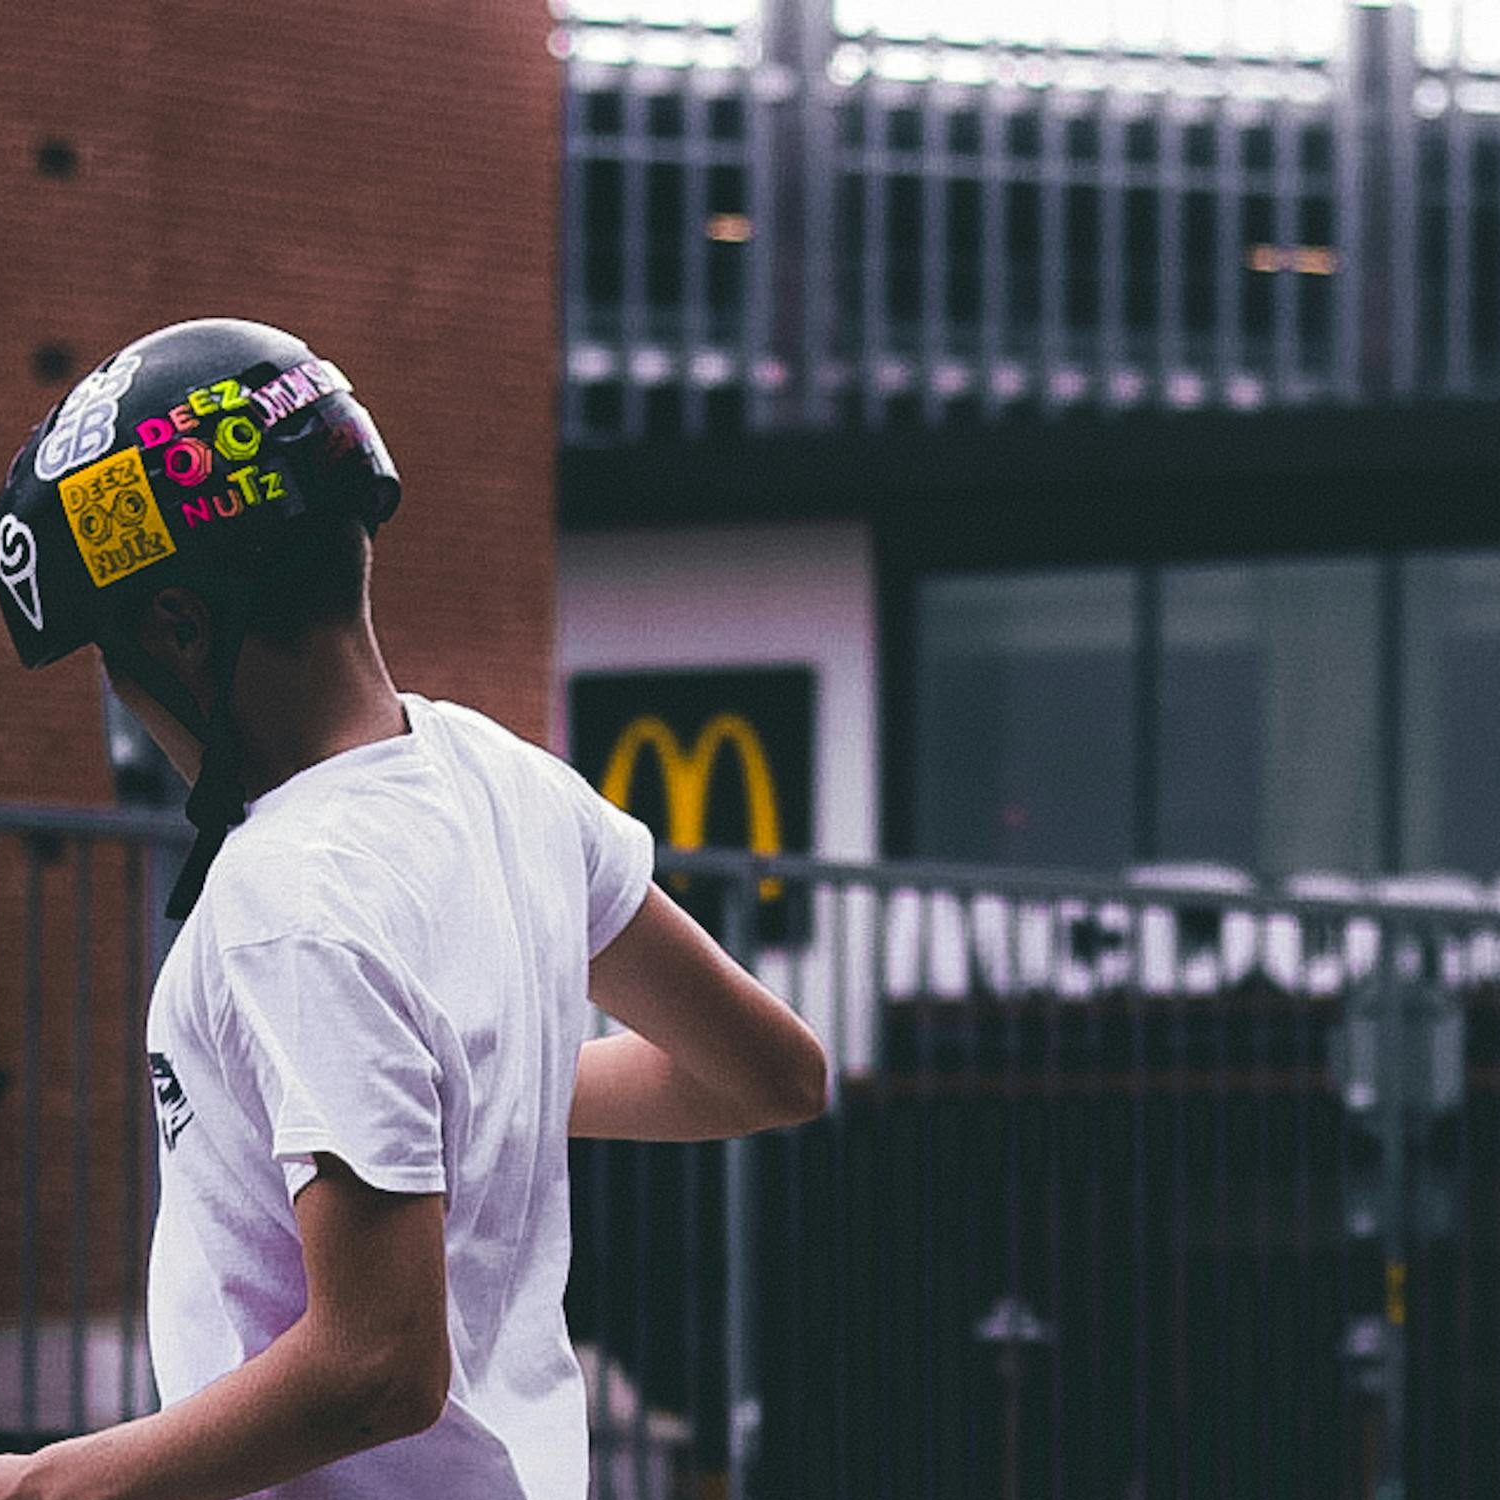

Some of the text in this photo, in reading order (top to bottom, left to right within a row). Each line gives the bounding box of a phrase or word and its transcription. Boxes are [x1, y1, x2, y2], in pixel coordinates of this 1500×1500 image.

[135, 378, 252, 450] DEEZ
[65, 459, 142, 512] DEEZ
[181, 465, 287, 529] NUTZ
